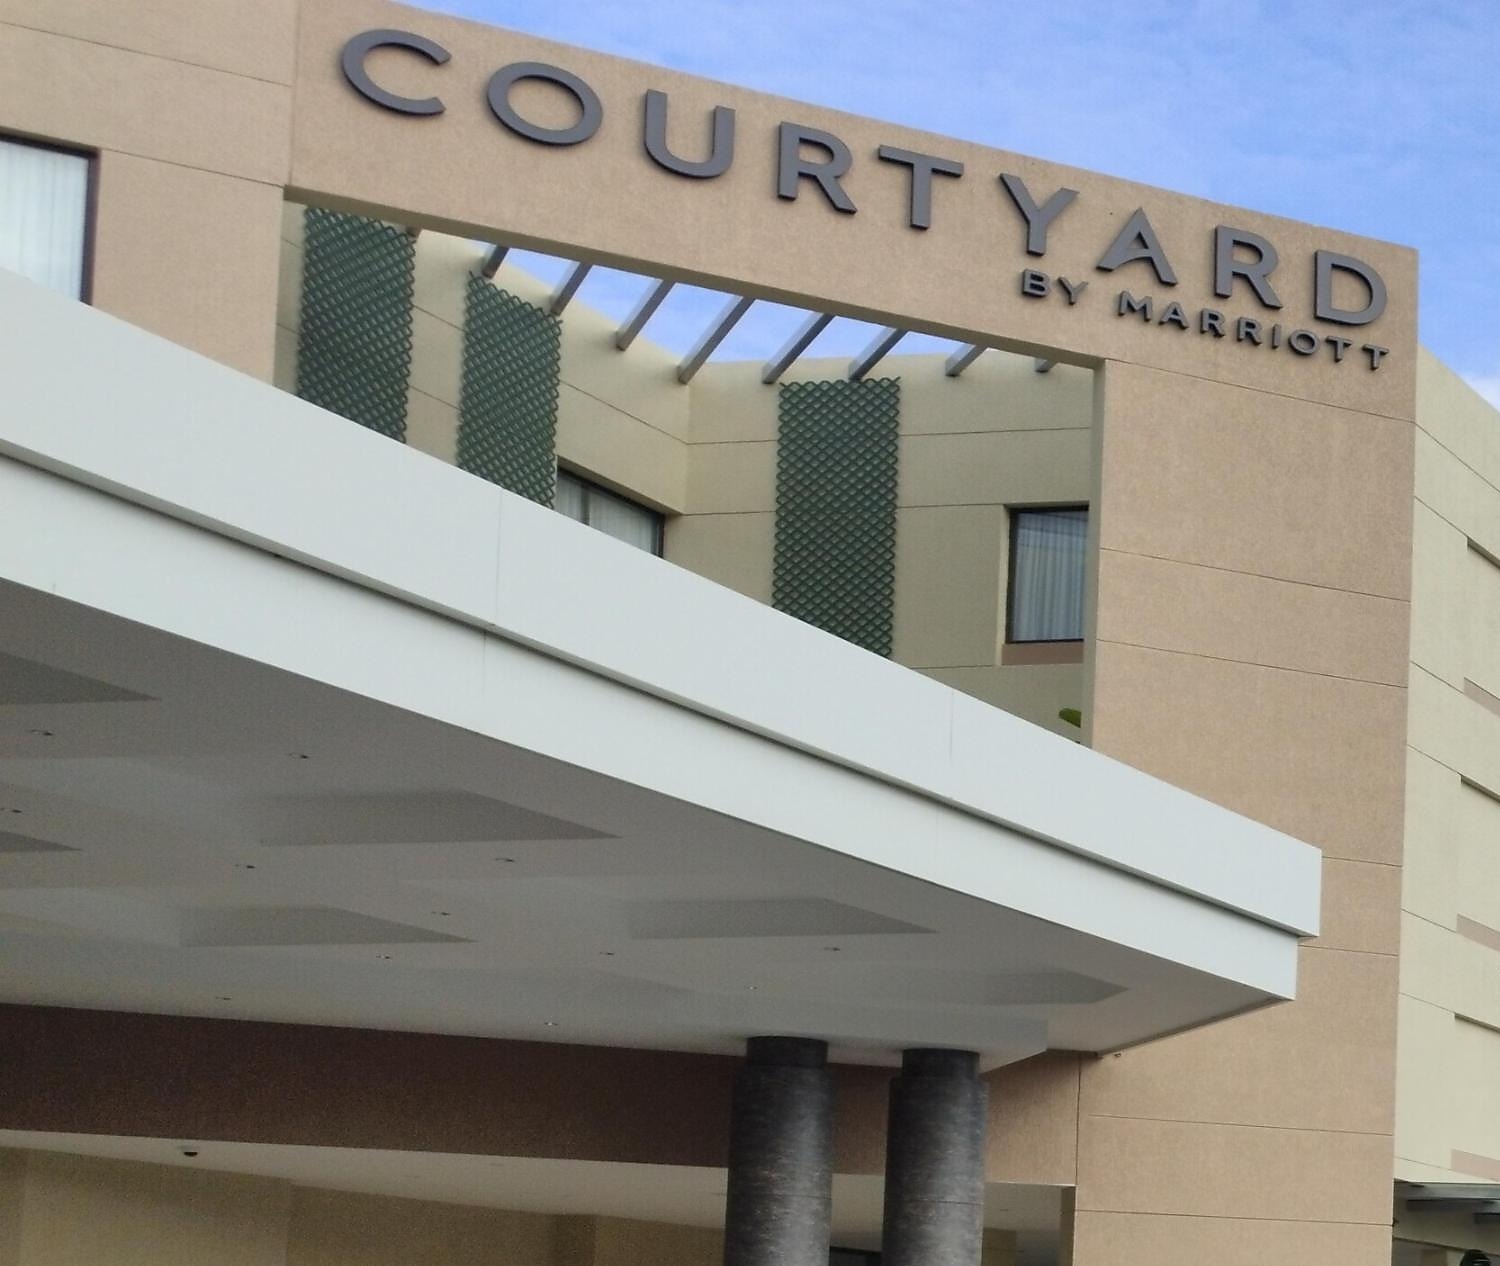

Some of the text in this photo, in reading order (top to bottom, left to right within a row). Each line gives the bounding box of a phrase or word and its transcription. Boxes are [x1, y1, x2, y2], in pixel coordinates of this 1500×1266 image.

[341, 28, 1388, 327] COURTYARD
[1021, 267, 1390, 371] BY MARRIOTT
